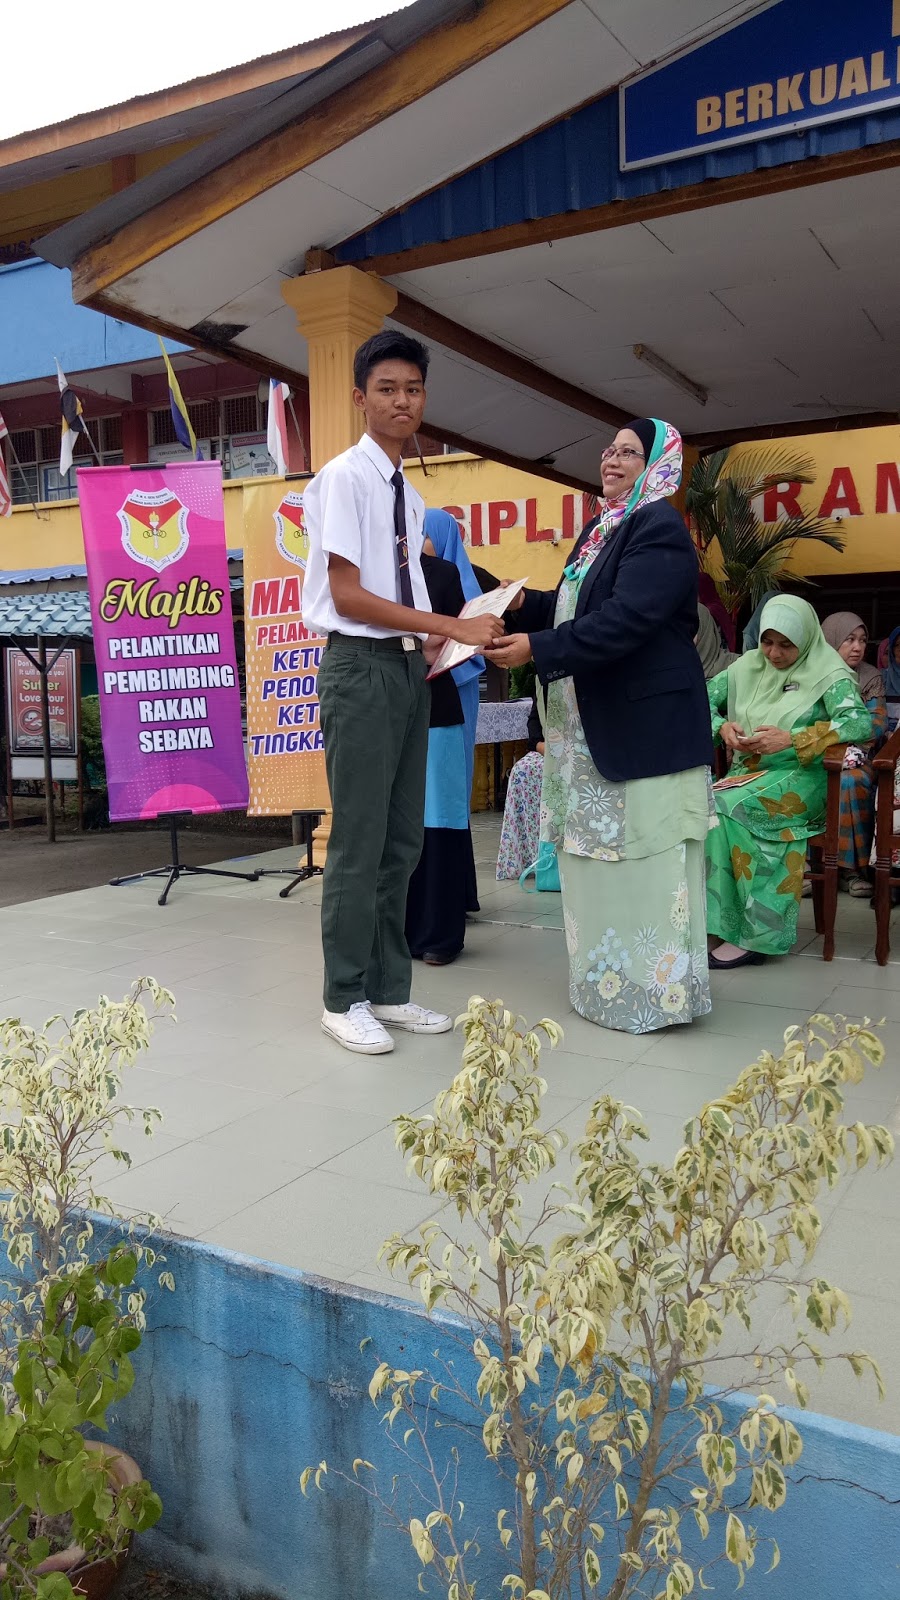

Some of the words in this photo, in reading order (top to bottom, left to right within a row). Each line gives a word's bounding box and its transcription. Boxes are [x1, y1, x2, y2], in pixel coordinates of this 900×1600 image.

[696, 46, 900, 135] BERKUAL
[100, 576, 224, 628] Majlis
[108, 633, 220, 659] PELANTIKAN
[257, 621, 327, 646] PELAN
[22, 679, 60, 690] Sufer
[103, 665, 235, 694] PEMBIMBING
[262, 675, 318, 700] PENO
[19, 693, 42, 702] Love
[47, 693, 65, 702] our
[138, 697, 208, 722] RAKAN
[48, 705, 65, 716] Life
[138, 727, 214, 753] SEBAYA
[251, 729, 325, 755] TINGKA
